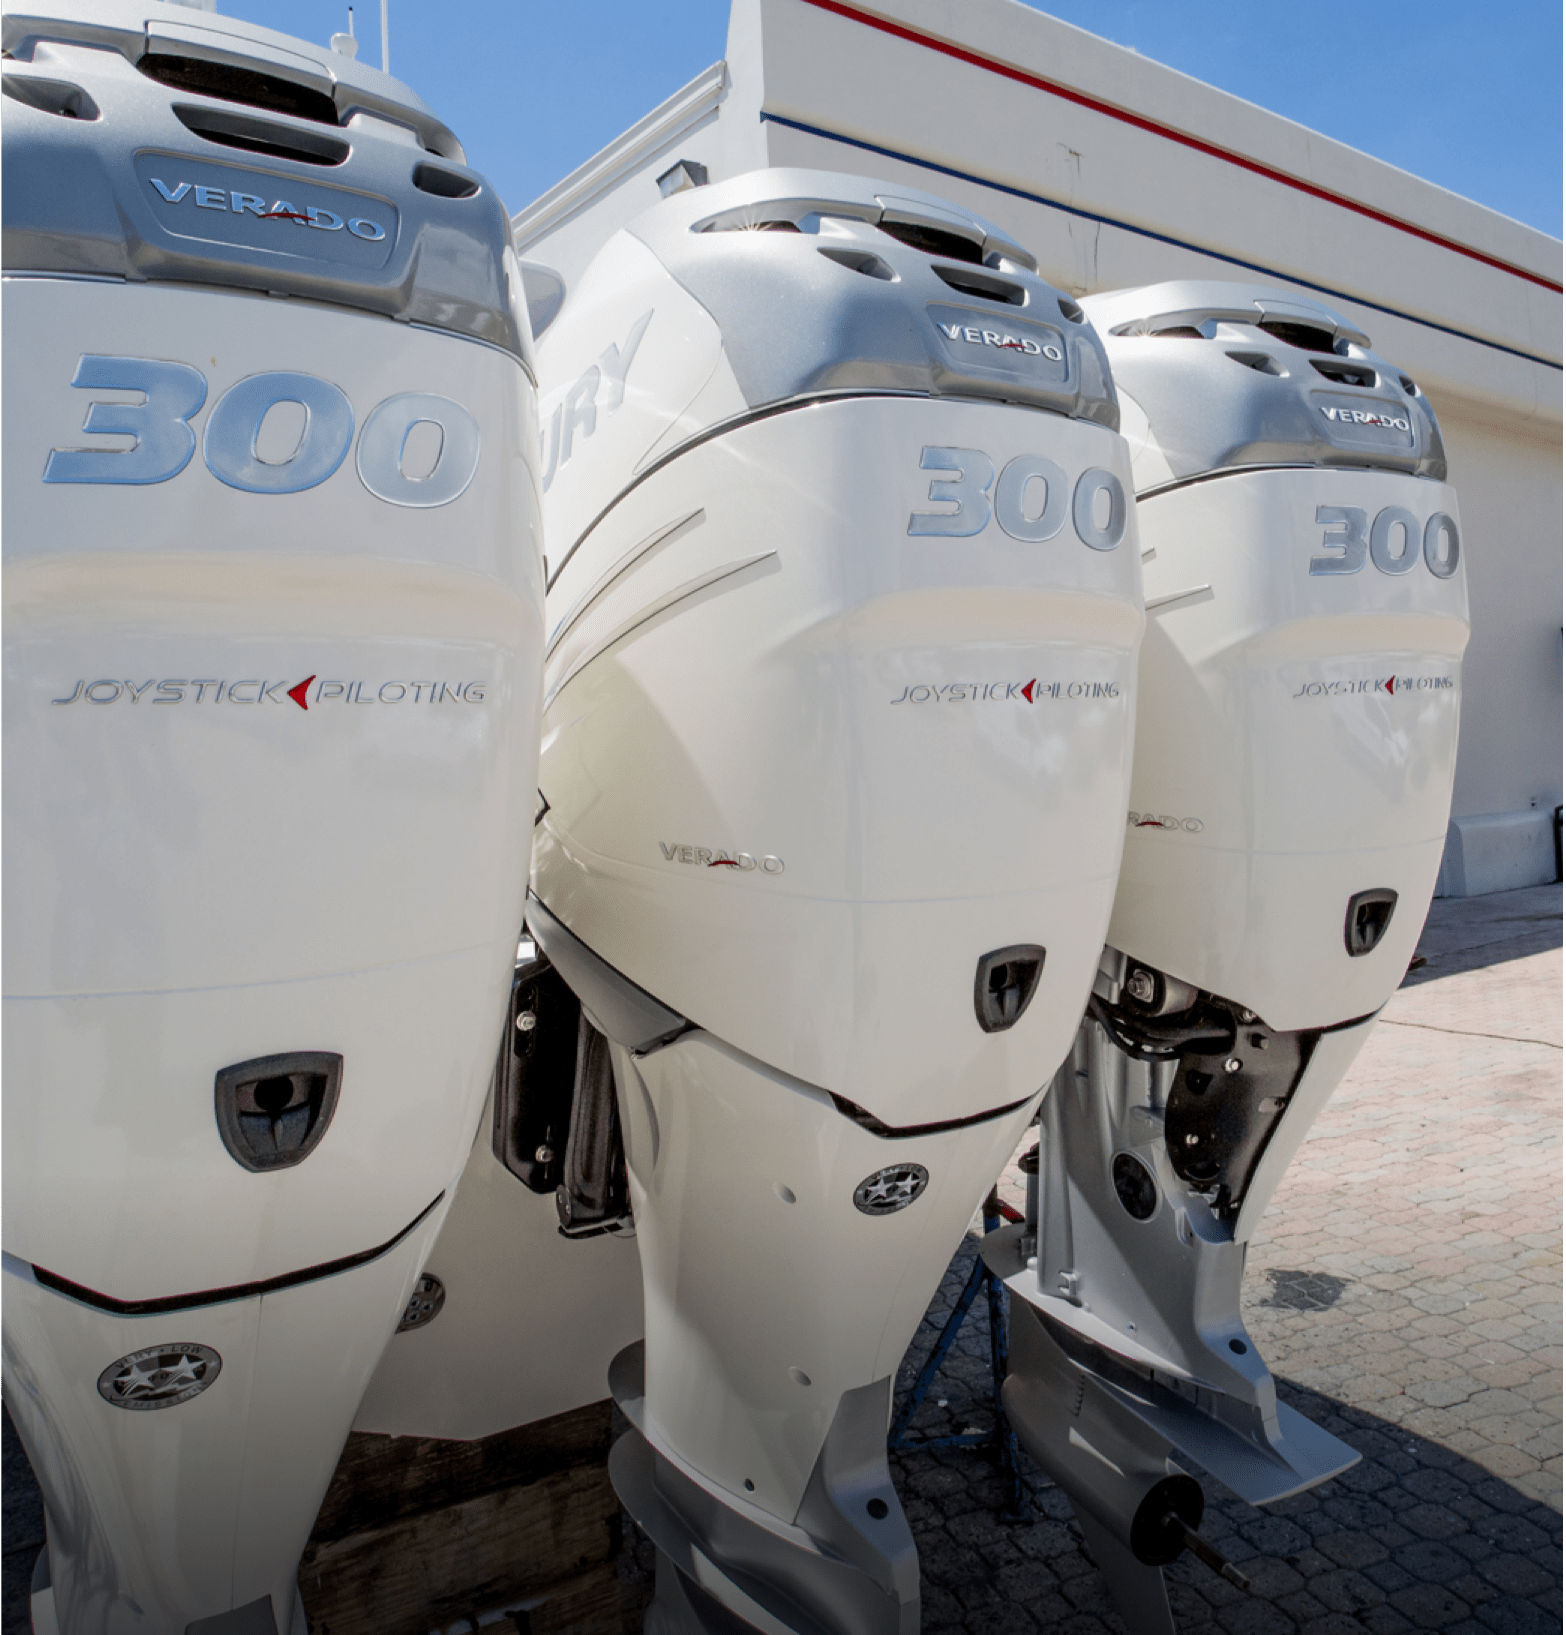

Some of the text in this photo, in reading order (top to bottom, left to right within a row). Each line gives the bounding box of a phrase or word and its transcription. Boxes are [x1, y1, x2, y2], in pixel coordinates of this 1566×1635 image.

[149, 177, 386, 242] VERADO
[936, 322, 1063, 362] VERADO
[42, 353, 482, 509] 300
[1319, 406, 1410, 432] VERADO
[907, 445, 1127, 552] 300
[1309, 504, 1460, 579] 300
[51, 679, 487, 705] JOYSTICK PILOTING
[890, 681, 1121, 706] JOYSTICK PILOTING
[1292, 675, 1454, 699] JOYSTICK PILOTING
[658, 840, 786, 875] VERADO
[170, 1344, 204, 1355] LOW
